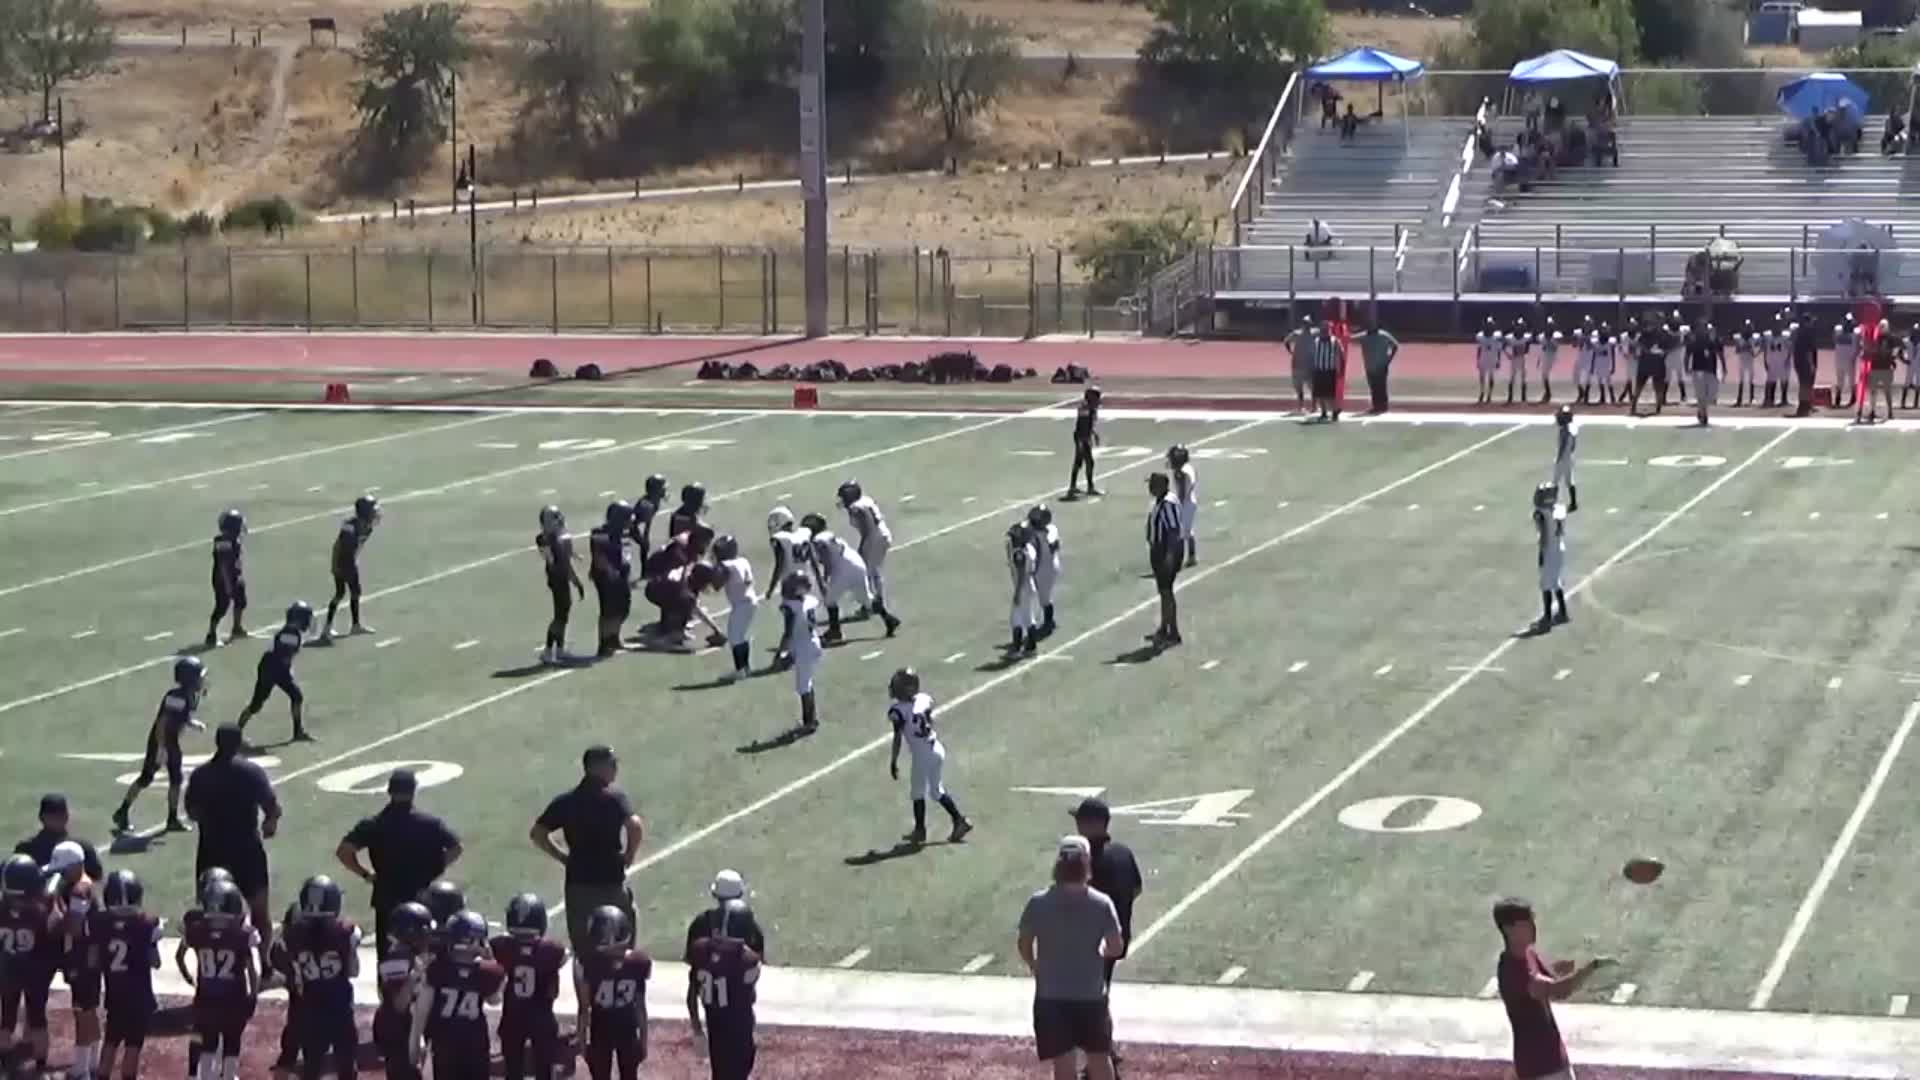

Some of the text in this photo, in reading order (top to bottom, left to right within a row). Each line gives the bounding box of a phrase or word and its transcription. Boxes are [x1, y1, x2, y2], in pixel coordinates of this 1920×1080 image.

[1106, 788, 1484, 833] 40
[108, 938, 128, 972] 2
[298, 950, 343, 980] 35
[513, 965, 535, 998] 3
[595, 979, 637, 1008] 43
[440, 986, 480, 1020] 74
